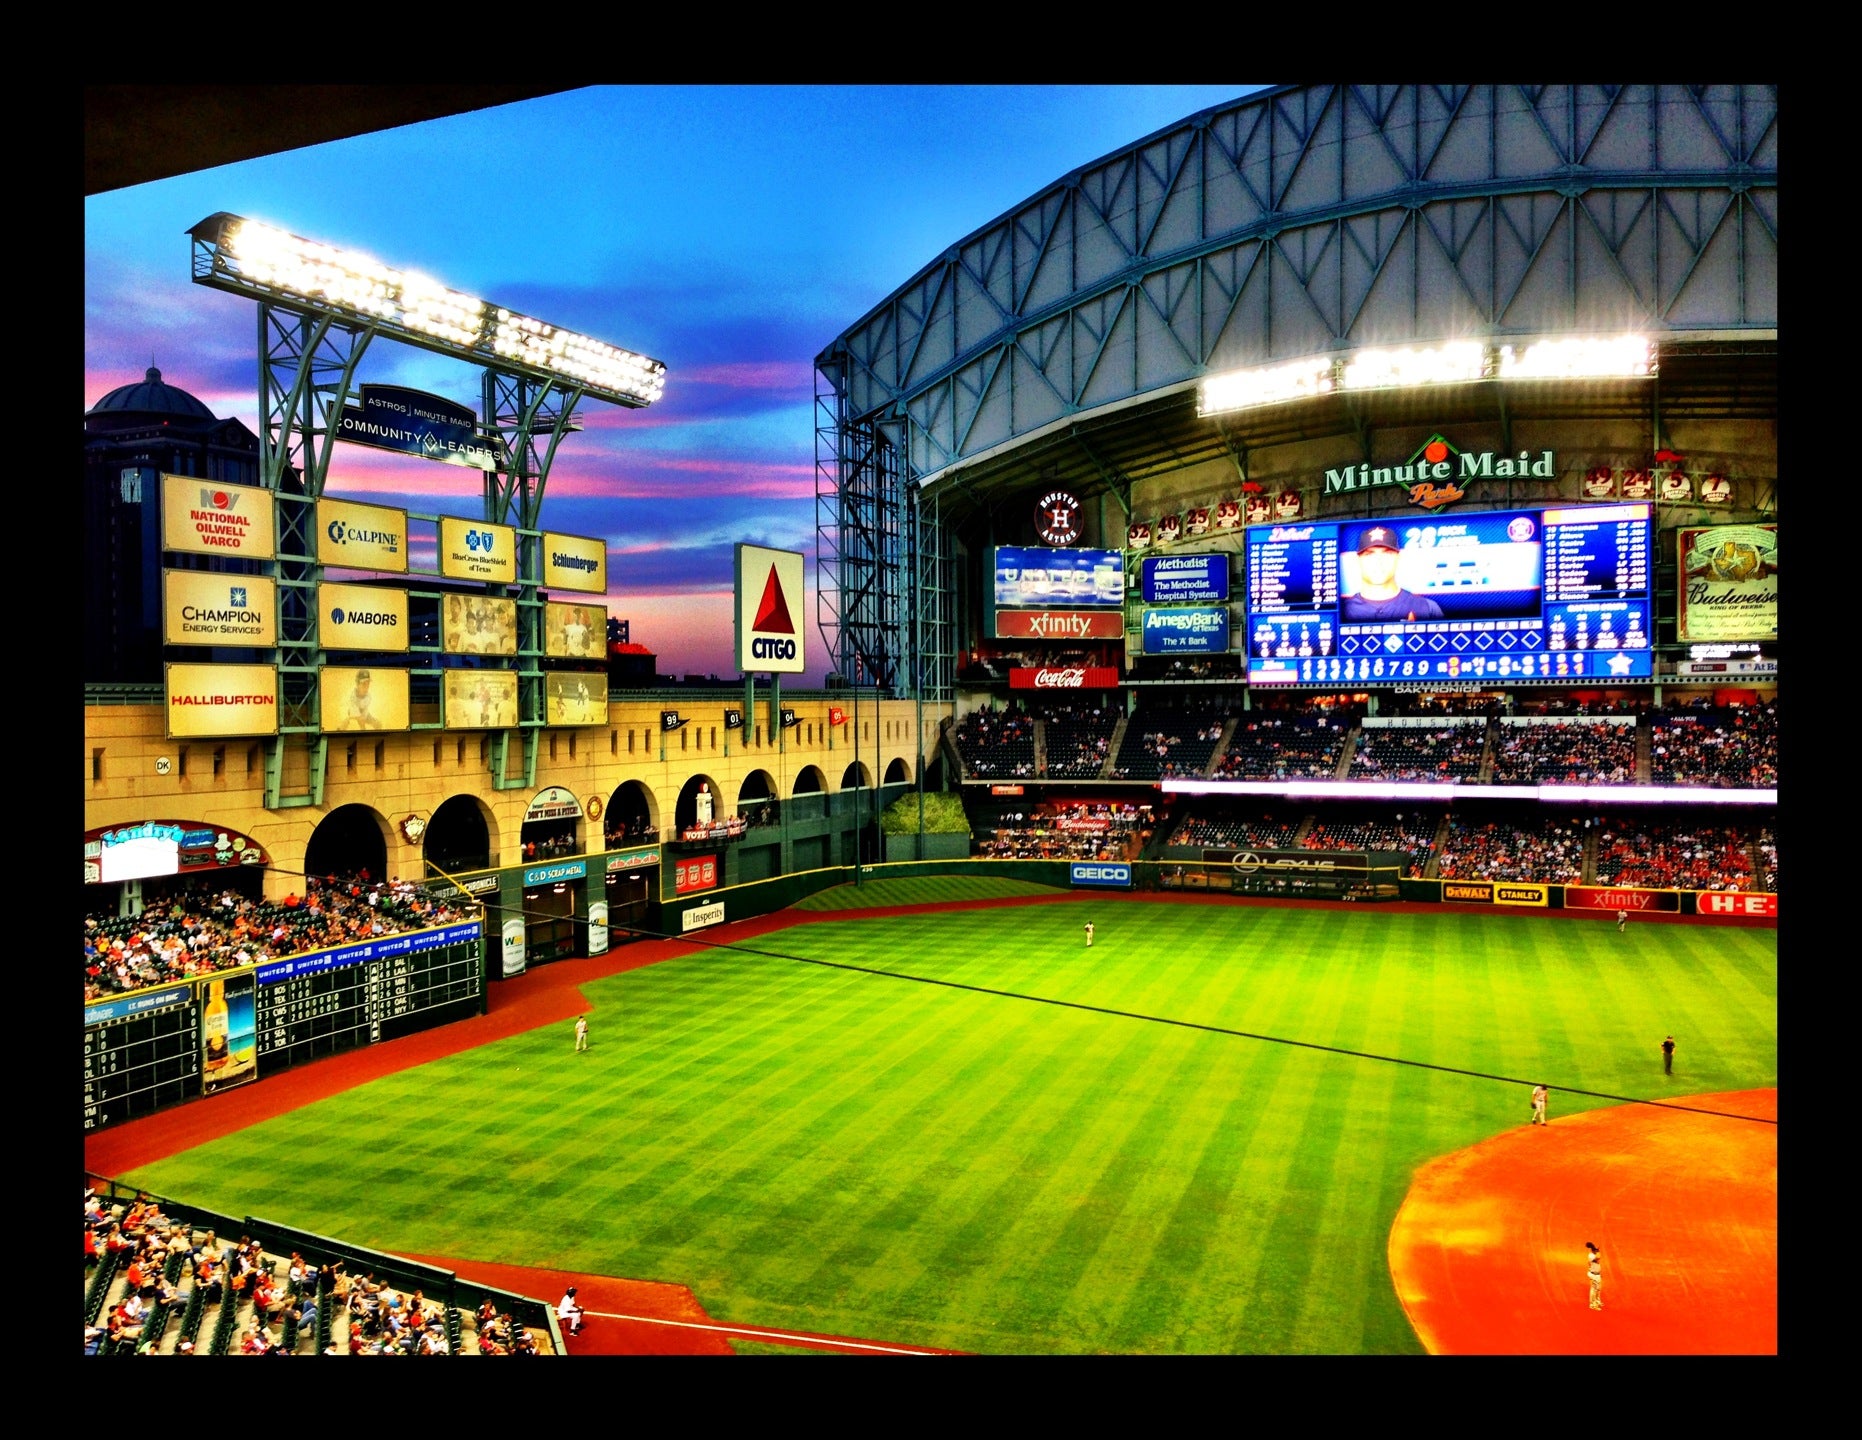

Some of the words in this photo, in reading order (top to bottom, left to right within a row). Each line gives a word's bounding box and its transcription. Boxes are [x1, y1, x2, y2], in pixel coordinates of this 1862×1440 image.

[368, 398, 406, 412] ASTROS
[414, 408, 447, 423] MINUTE
[450, 417, 472, 428] MAID
[439, 441, 502, 460] LEADERS
[1324, 459, 1450, 494] Minute
[1458, 450, 1555, 478] Maid
[1624, 468, 1650, 486] 24
[1670, 472, 1682, 488] 5
[1710, 474, 1722, 490] 7
[1040, 492, 1079, 509] HOUSTON
[1409, 483, 1463, 504] Park
[1188, 509, 1208, 524] 25
[1218, 502, 1239, 518] 33
[190, 510, 250, 526] NATIONAL
[1052, 510, 1070, 528] H
[1158, 515, 1178, 532] 40
[196, 522, 246, 537] OILWELL
[202, 535, 241, 548] VARCO
[348, 529, 398, 546] CALPINE
[1042, 530, 1076, 544] ASTROS
[1405, 527, 1437, 548] 28
[452, 553, 479, 562] BlueCross
[480, 555, 506, 566] BlueShield
[553, 552, 598, 573] Schlumberger
[1154, 558, 1208, 571] Methodist
[1154, 582, 1170, 590] The
[1171, 580, 1210, 590] Methodist
[1154, 592, 1188, 602] Hospital
[1188, 590, 1218, 600] System
[182, 606, 260, 624] CHAMPION
[348, 612, 397, 626] NABORS
[1147, 612, 1223, 630] AmegyBank
[182, 623, 218, 633] ENERGY
[220, 624, 262, 634] SERVICES
[1030, 613, 1091, 636] xfinity
[1163, 638, 1176, 646] The
[1188, 636, 1208, 646] Bank
[752, 638, 796, 660] CITGO
[1389, 662, 1399, 675] 7
[1403, 661, 1413, 675] 8
[1418, 661, 1428, 675] 9
[1034, 668, 1086, 688] Coca-Cola
[172, 695, 274, 705] HALLIBURTON
[667, 715, 677, 725] 99
[730, 714, 739, 723] 01
[786, 713, 794, 722] 04
[157, 761, 169, 770] DK
[528, 810, 543, 819] DON'T
[1060, 820, 1107, 830] Budweiser
[102, 820, 185, 848] Landry's
[686, 831, 706, 840] VOTE
[1263, 859, 1335, 871] LEXUS
[529, 869, 546, 882] C&D
[548, 868, 566, 879] SCRAP
[566, 866, 582, 876] METAL
[1073, 867, 1128, 880] GEICO
[465, 876, 497, 891] CHRONICLE
[1501, 890, 1540, 900] STANLEY
[1594, 891, 1650, 910] xfinity
[693, 908, 723, 923] Insperity
[414, 936, 437, 944] UNITED
[449, 929, 471, 938] UNITED
[378, 943, 403, 952] UNITED
[337, 951, 363, 960] UNITED
[297, 958, 323, 969] UNITED
[258, 968, 285, 978] UNITED
